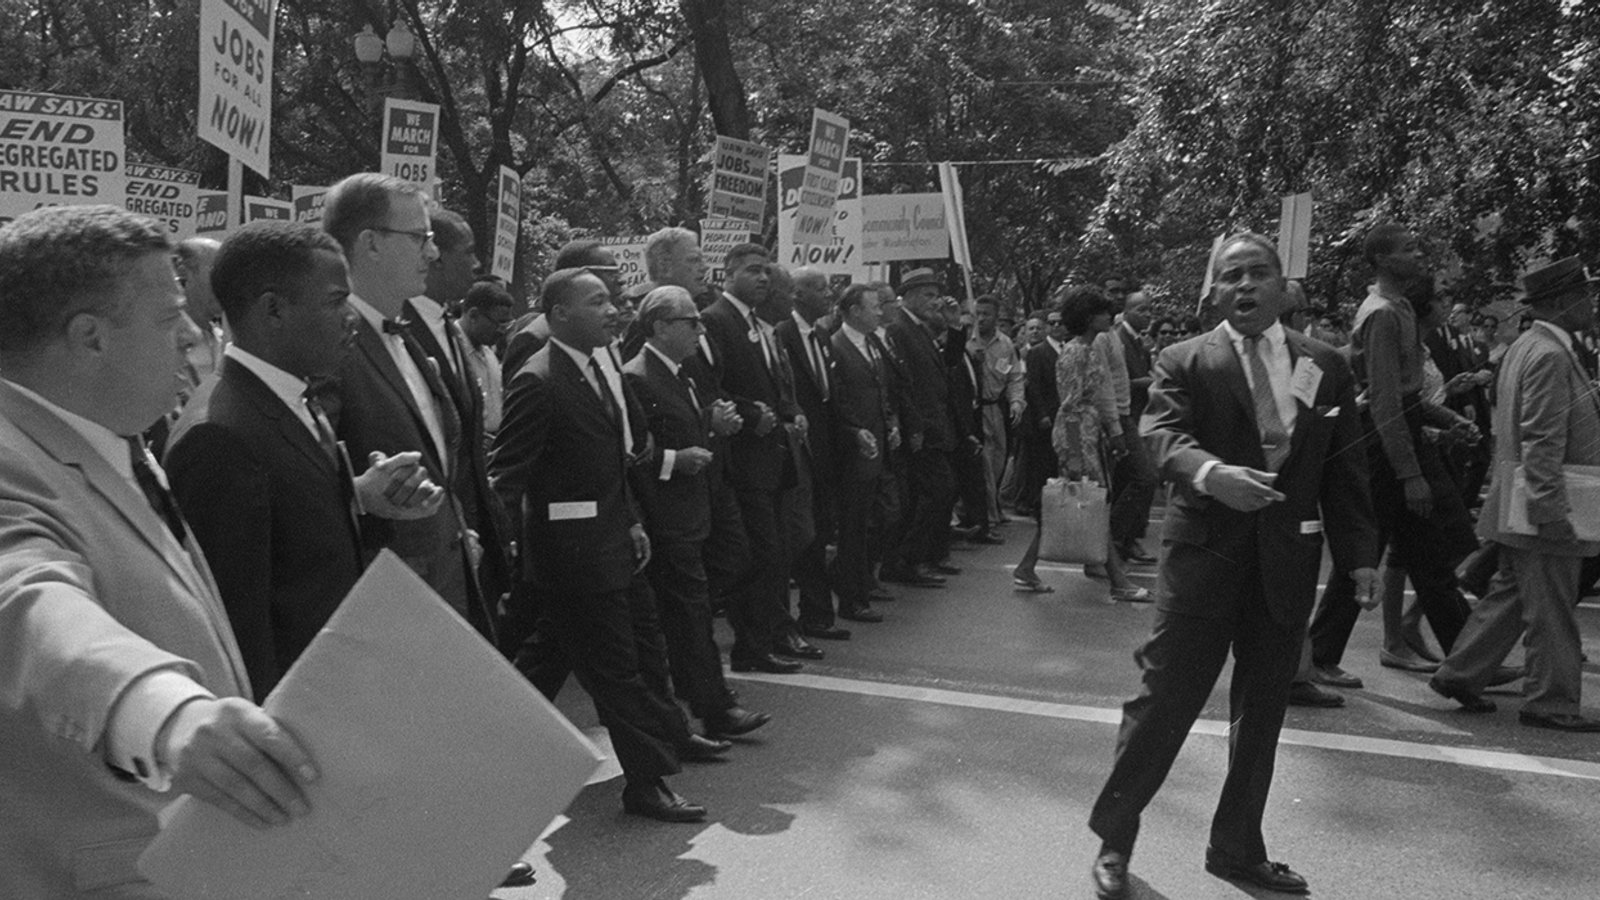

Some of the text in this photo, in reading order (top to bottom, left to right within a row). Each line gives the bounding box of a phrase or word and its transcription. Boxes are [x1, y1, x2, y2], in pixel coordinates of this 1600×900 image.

[213, 20, 264, 84] JOBS
[214, 61, 262, 108] FOR ALL
[0, 94, 118, 118] AW SAYS:
[211, 94, 265, 154] NOW!
[406, 113, 420, 126] WE
[0, 118, 95, 144] END
[391, 126, 431, 144] MARCH
[824, 125, 836, 140] WE
[403, 145, 419, 153] FOR
[722, 142, 742, 153] UAW
[815, 137, 841, 160] MARCH
[390, 163, 427, 183] JOBS
[717, 154, 750, 174] JOBS
[0, 170, 98, 197] RULES
[151, 167, 195, 183] SAYS:
[125, 181, 180, 199] END
[715, 174, 763, 199] FREEDOM
[125, 197, 193, 218] GREGATED
[264, 208, 279, 219] WE
[798, 215, 830, 236] NOW!
[606, 237, 631, 245] UAW
[704, 233, 748, 242] PEOPLE ARE
[791, 244, 855, 265] NOW!
